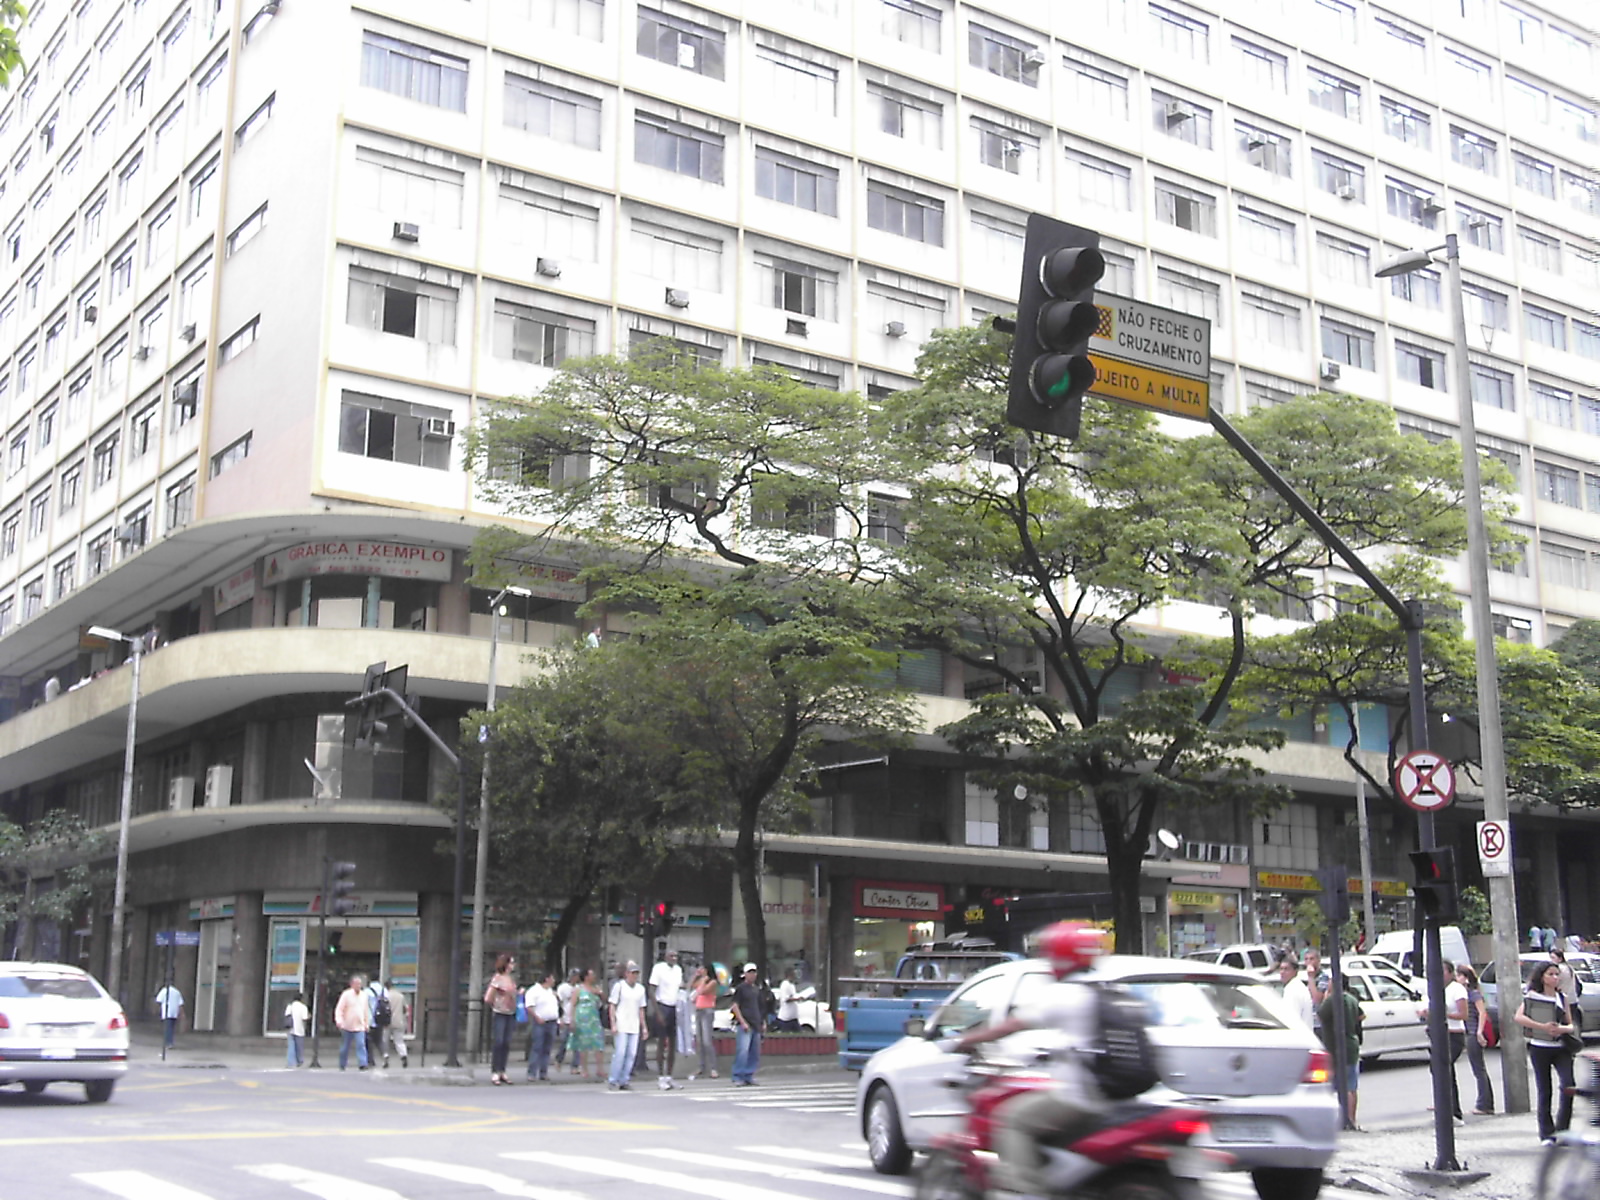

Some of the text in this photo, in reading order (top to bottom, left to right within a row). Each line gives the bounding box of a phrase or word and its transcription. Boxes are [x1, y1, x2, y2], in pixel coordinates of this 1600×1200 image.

[1118, 306, 1202, 343] NÃO FECHE O
[1118, 332, 1202, 365] CRUZAMENTO
[1095, 368, 1201, 405] UJEITO A MULTA
[358, 543, 446, 563] EXEMPLO
